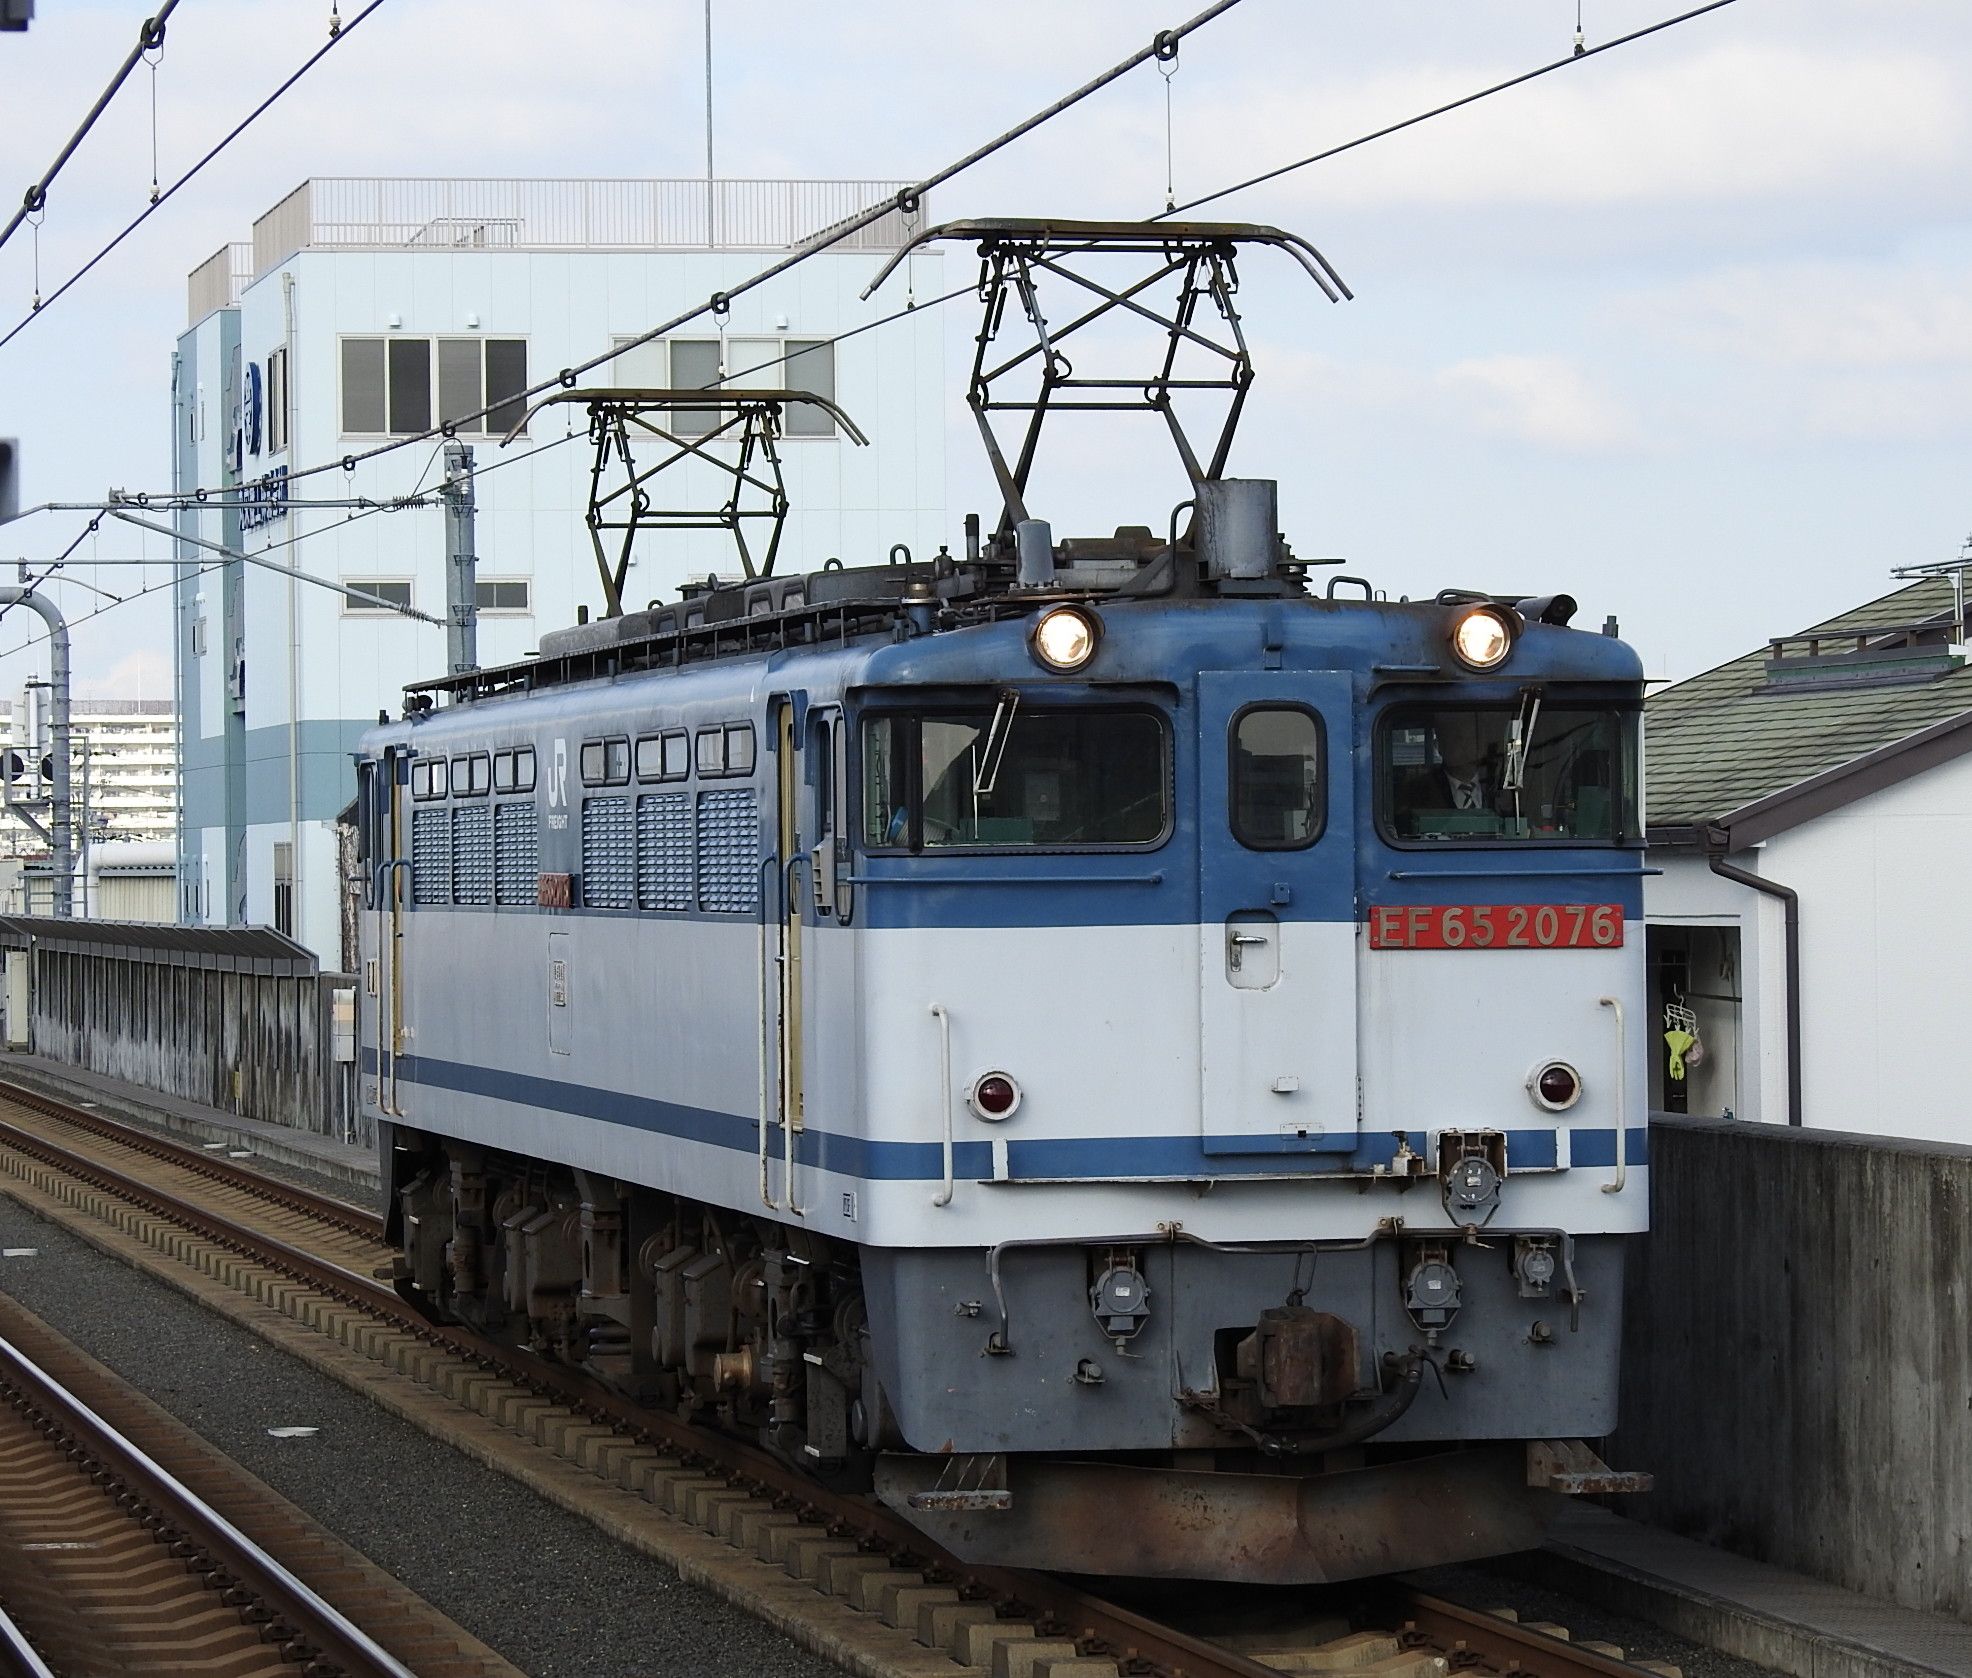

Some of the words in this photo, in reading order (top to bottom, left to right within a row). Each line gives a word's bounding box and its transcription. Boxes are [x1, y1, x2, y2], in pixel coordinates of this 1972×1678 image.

[548, 738, 567, 807] JR
[1379, 907, 1433, 947] EF
[1441, 907, 1495, 946] 65
[1506, 906, 1616, 946] 2076
